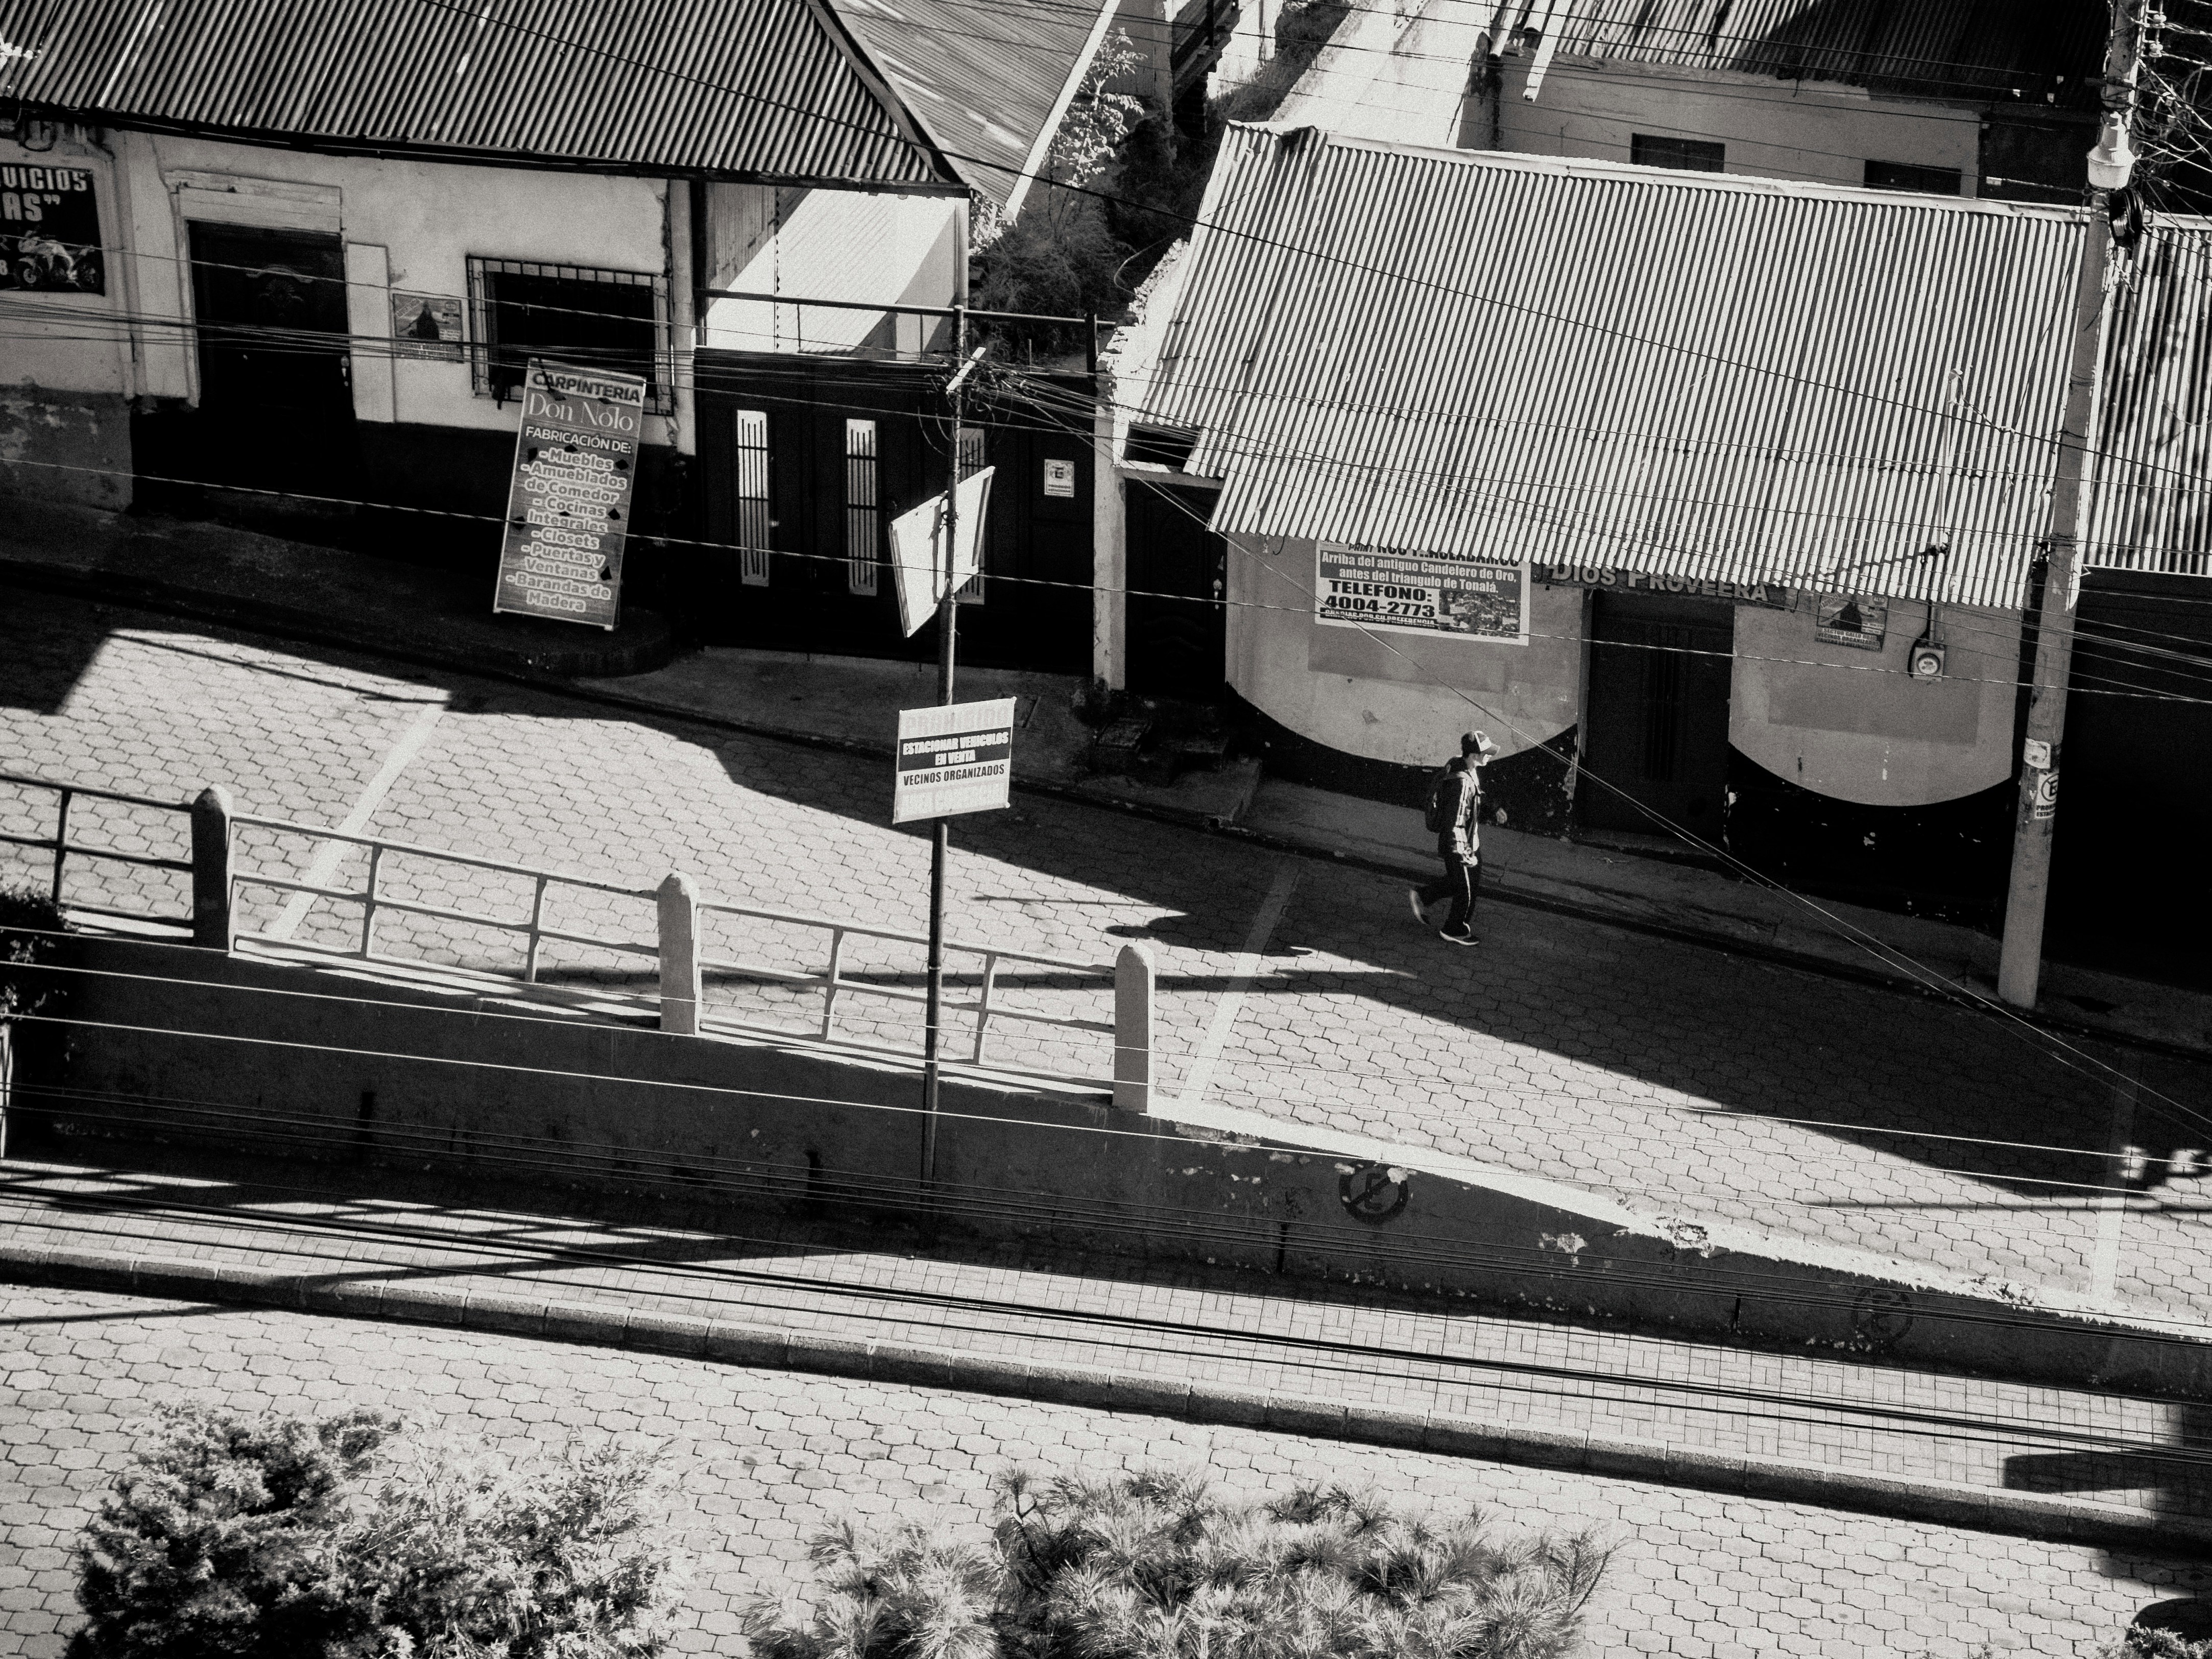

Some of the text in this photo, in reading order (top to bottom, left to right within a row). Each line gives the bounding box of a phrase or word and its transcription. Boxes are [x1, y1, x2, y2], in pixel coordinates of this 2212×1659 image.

[0, 166, 87, 191] VICIOS
[532, 373, 640, 402] CARPINTERIA
[528, 393, 633, 430] Don Nolo
[525, 426, 632, 453] FABRICACIÓN DE:
[524, 477, 619, 504] de Comedor
[545, 495, 606, 519] Cocinas
[527, 509, 608, 535] Integrales
[524, 556, 598, 582] Ventanas
[592, 554, 606, 568] y
[1322, 551, 1355, 565] Arriba
[1358, 556, 1375, 567] del
[1378, 559, 1418, 571] antiguo
[1421, 562, 1477, 578] Candelero
[1480, 568, 1493, 579] de
[1496, 569, 1517, 583] Oro,
[590, 584, 611, 600] de
[1329, 580, 1432, 602] TELEFONO:
[1339, 568, 1498, 593] antes del triangulo de Tonalá.
[526, 589, 586, 612] Madera
[1325, 595, 1435, 617] 4004-2773
[903, 732, 1009, 755] ESTACIONAR VEHICULOS
[935, 750, 975, 765] EN VENTA
[903, 764, 1004, 786] VECINOS ORGANIZADOS
